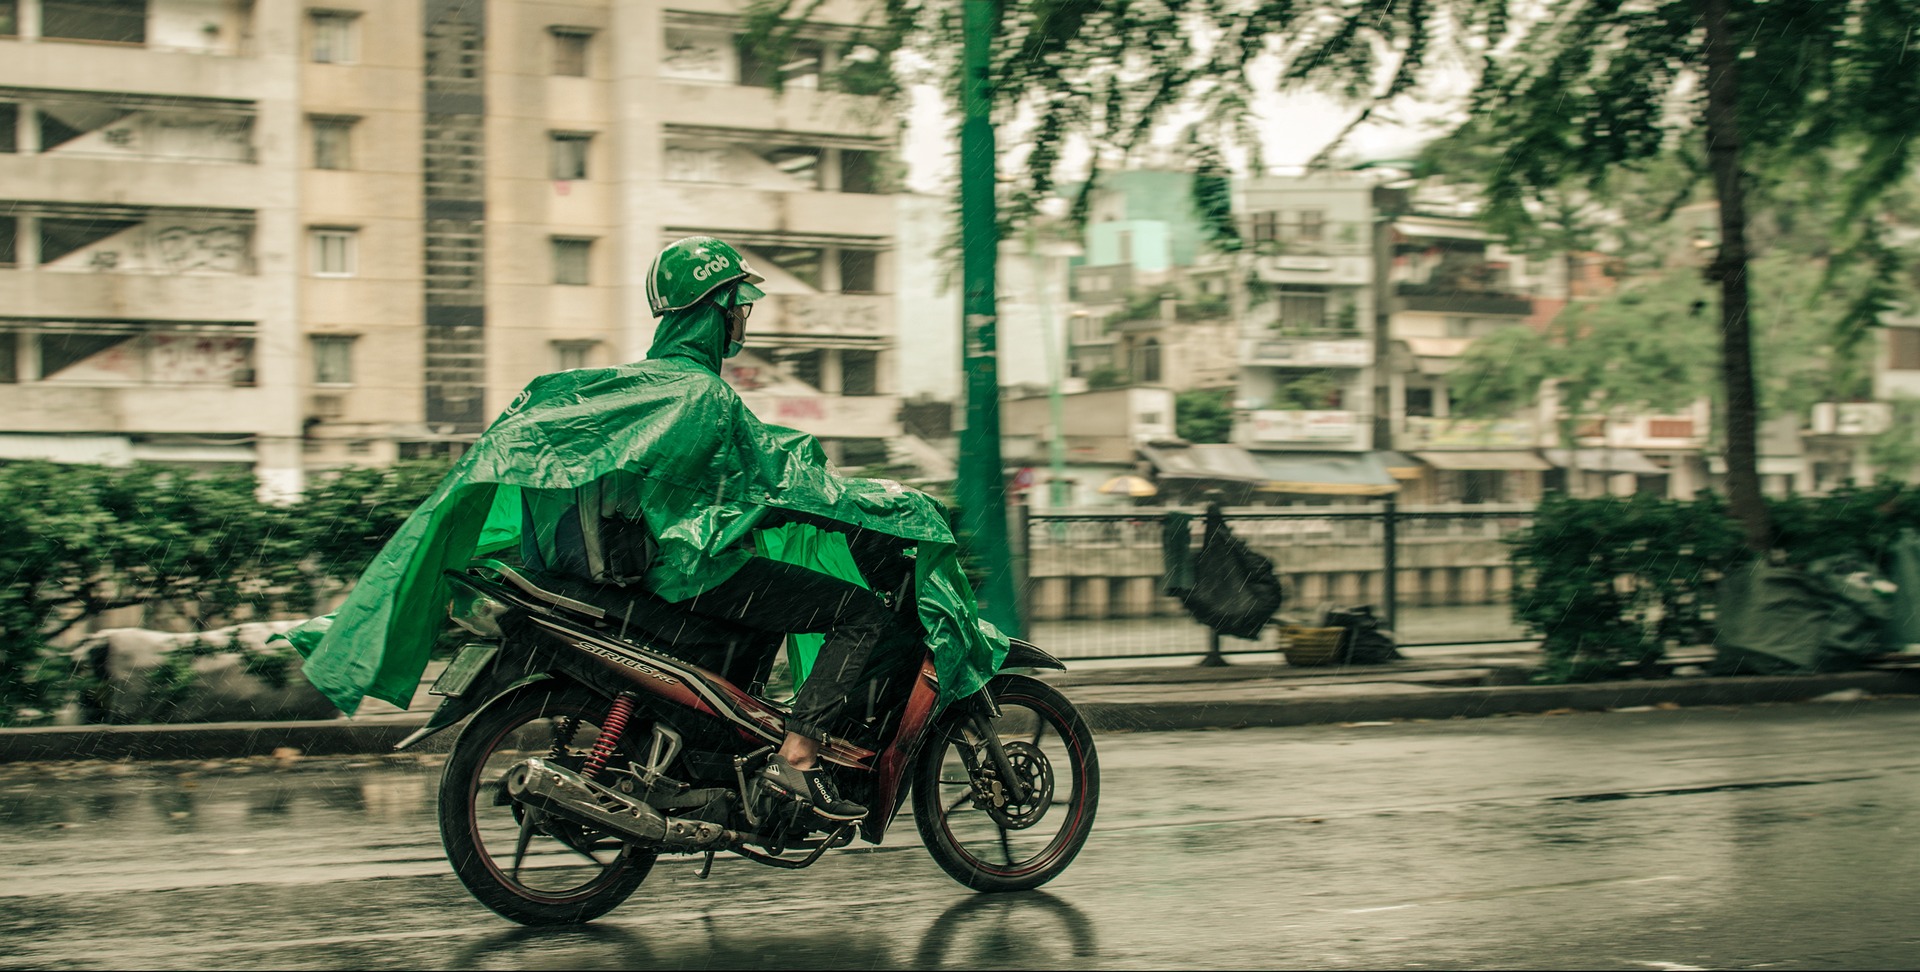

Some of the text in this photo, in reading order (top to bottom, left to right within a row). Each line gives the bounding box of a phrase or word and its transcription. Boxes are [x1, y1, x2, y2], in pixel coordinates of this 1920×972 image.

[693, 254, 730, 281] Grab
[572, 641, 659, 675] SIRIUS
[813, 777, 833, 804] adidas
